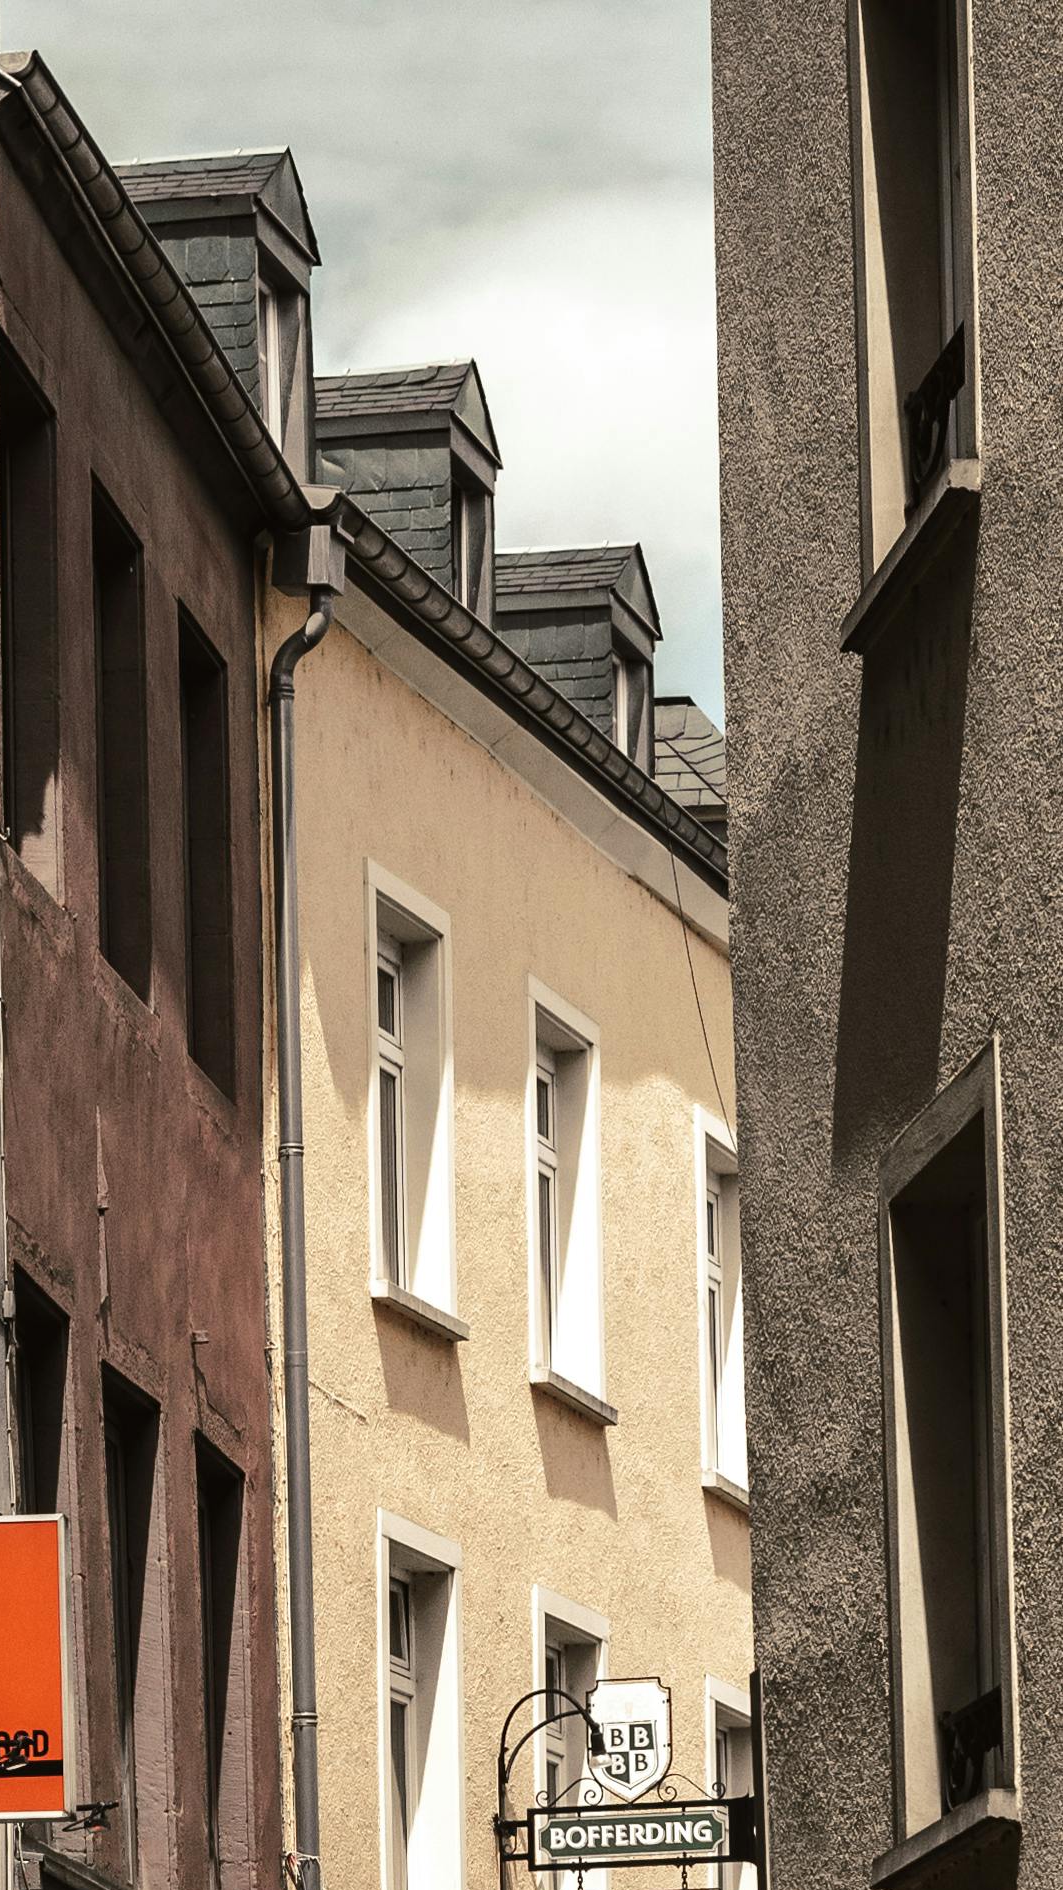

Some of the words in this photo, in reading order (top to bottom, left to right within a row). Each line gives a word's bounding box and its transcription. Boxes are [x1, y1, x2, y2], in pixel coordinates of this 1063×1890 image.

[610, 1728, 624, 1747] B
[634, 1727, 650, 1748] B
[611, 1754, 627, 1775] B
[634, 1753, 648, 1772] B
[548, 1819, 714, 1851] BOFFERDING
